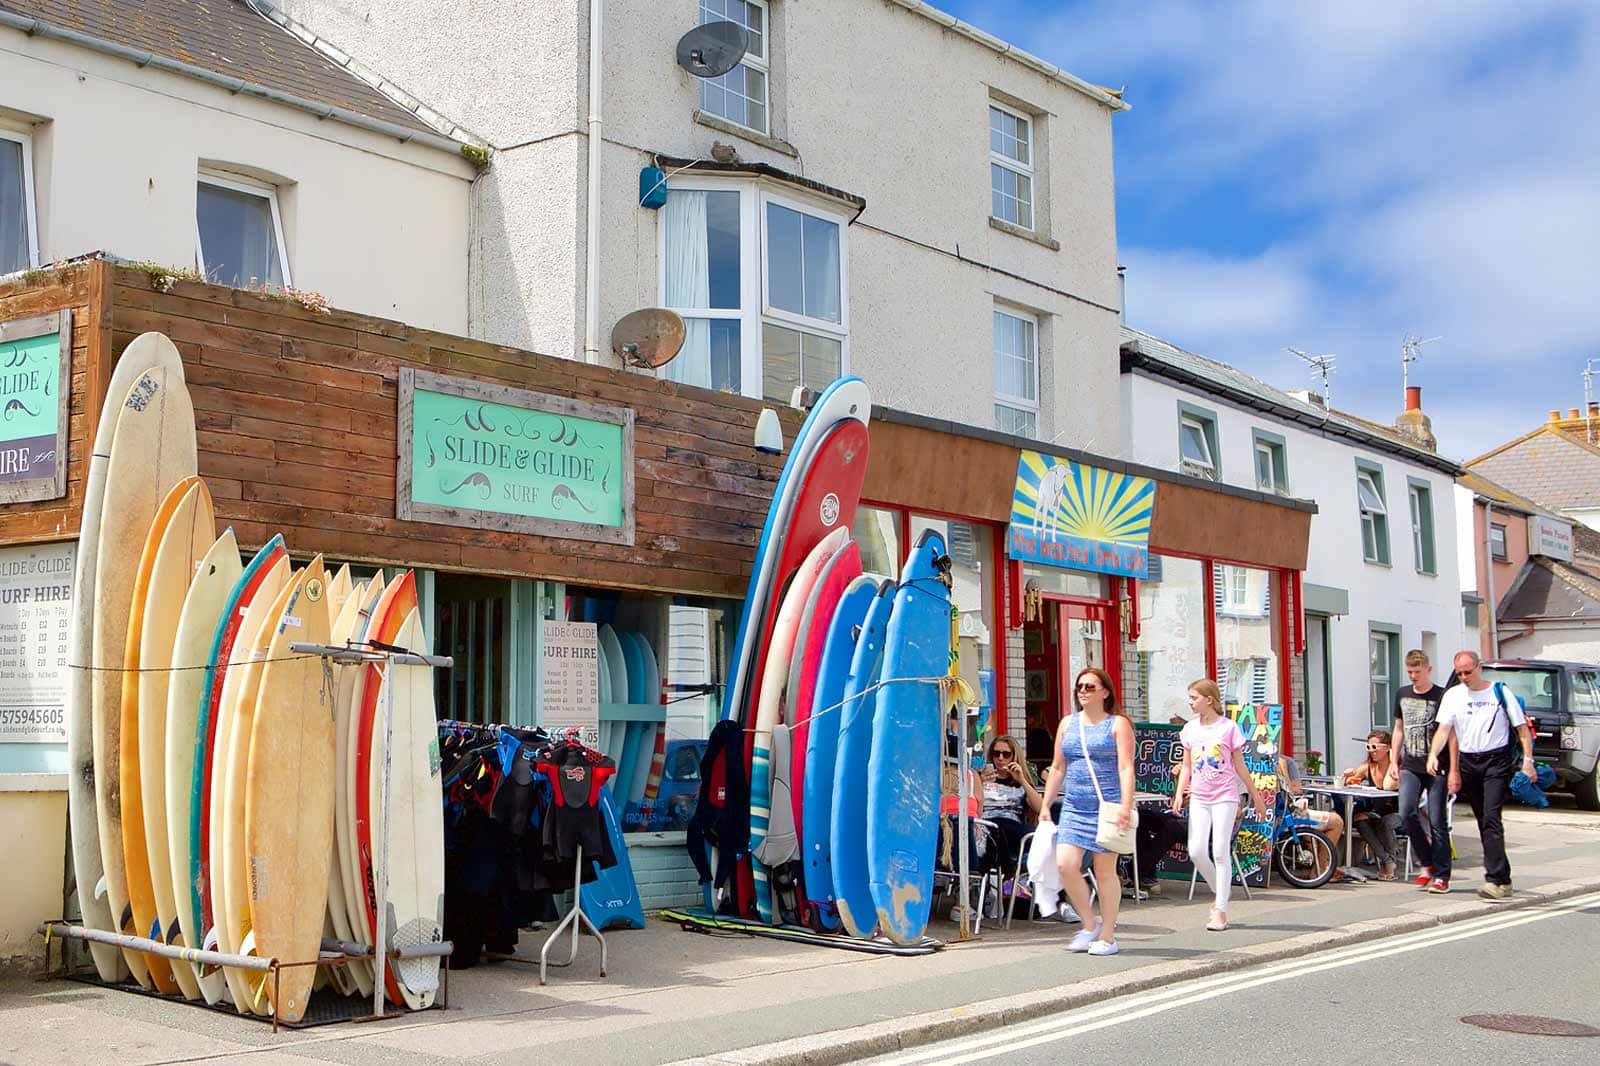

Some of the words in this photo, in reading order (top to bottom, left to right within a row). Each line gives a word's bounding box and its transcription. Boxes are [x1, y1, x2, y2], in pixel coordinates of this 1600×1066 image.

[0, 371, 39, 396] LIDE
[503, 484, 540, 503] SURF
[0, 557, 71, 576] LIDE&GLIDE
[0, 588, 31, 604] URF
[34, 585, 70, 602] HIRE
[571, 647, 597, 659] HIRE
[1226, 704, 1283, 726] TAKE
